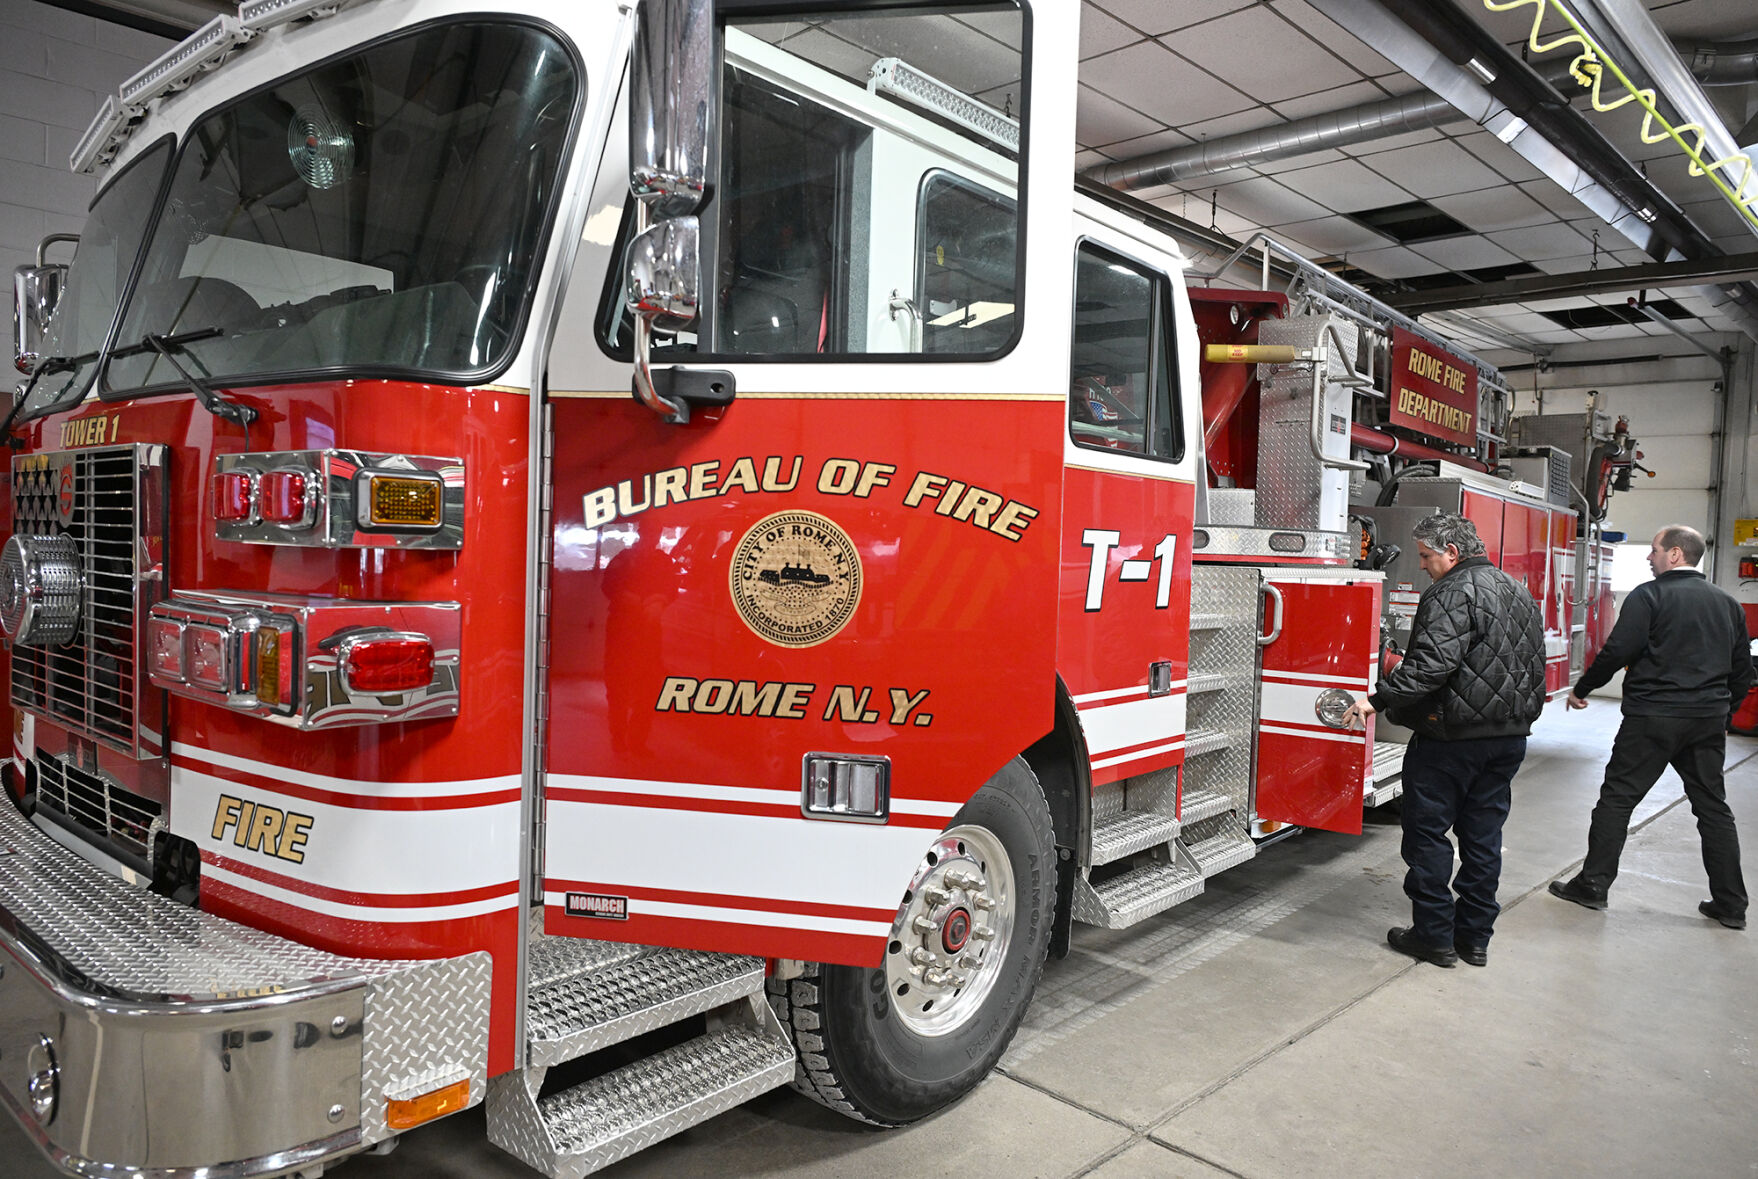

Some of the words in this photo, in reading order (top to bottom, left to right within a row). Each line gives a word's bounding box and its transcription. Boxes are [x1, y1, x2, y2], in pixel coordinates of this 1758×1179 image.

[1408, 347, 1443, 384] ROME
[1443, 364, 1467, 395] FIRE
[59, 416, 107, 448] TOWER
[110, 414, 120, 443] 1
[1398, 387, 1473, 434] DEPARTMENT
[583, 456, 803, 530] BUREAU
[817, 457, 897, 498] OF
[902, 471, 1040, 542] FIRE
[742, 541, 764, 581] CITY
[765, 526, 786, 542] OF
[792, 525, 836, 551] ROME
[1081, 528, 1177, 613] T-1
[746, 594, 823, 633] INCORPORATED
[825, 597, 845, 621] 1870
[655, 676, 816, 720] ROME
[822, 685, 933, 726] N.Y.
[211, 793, 315, 865] FIRE
[569, 895, 625, 914] MONARCH
